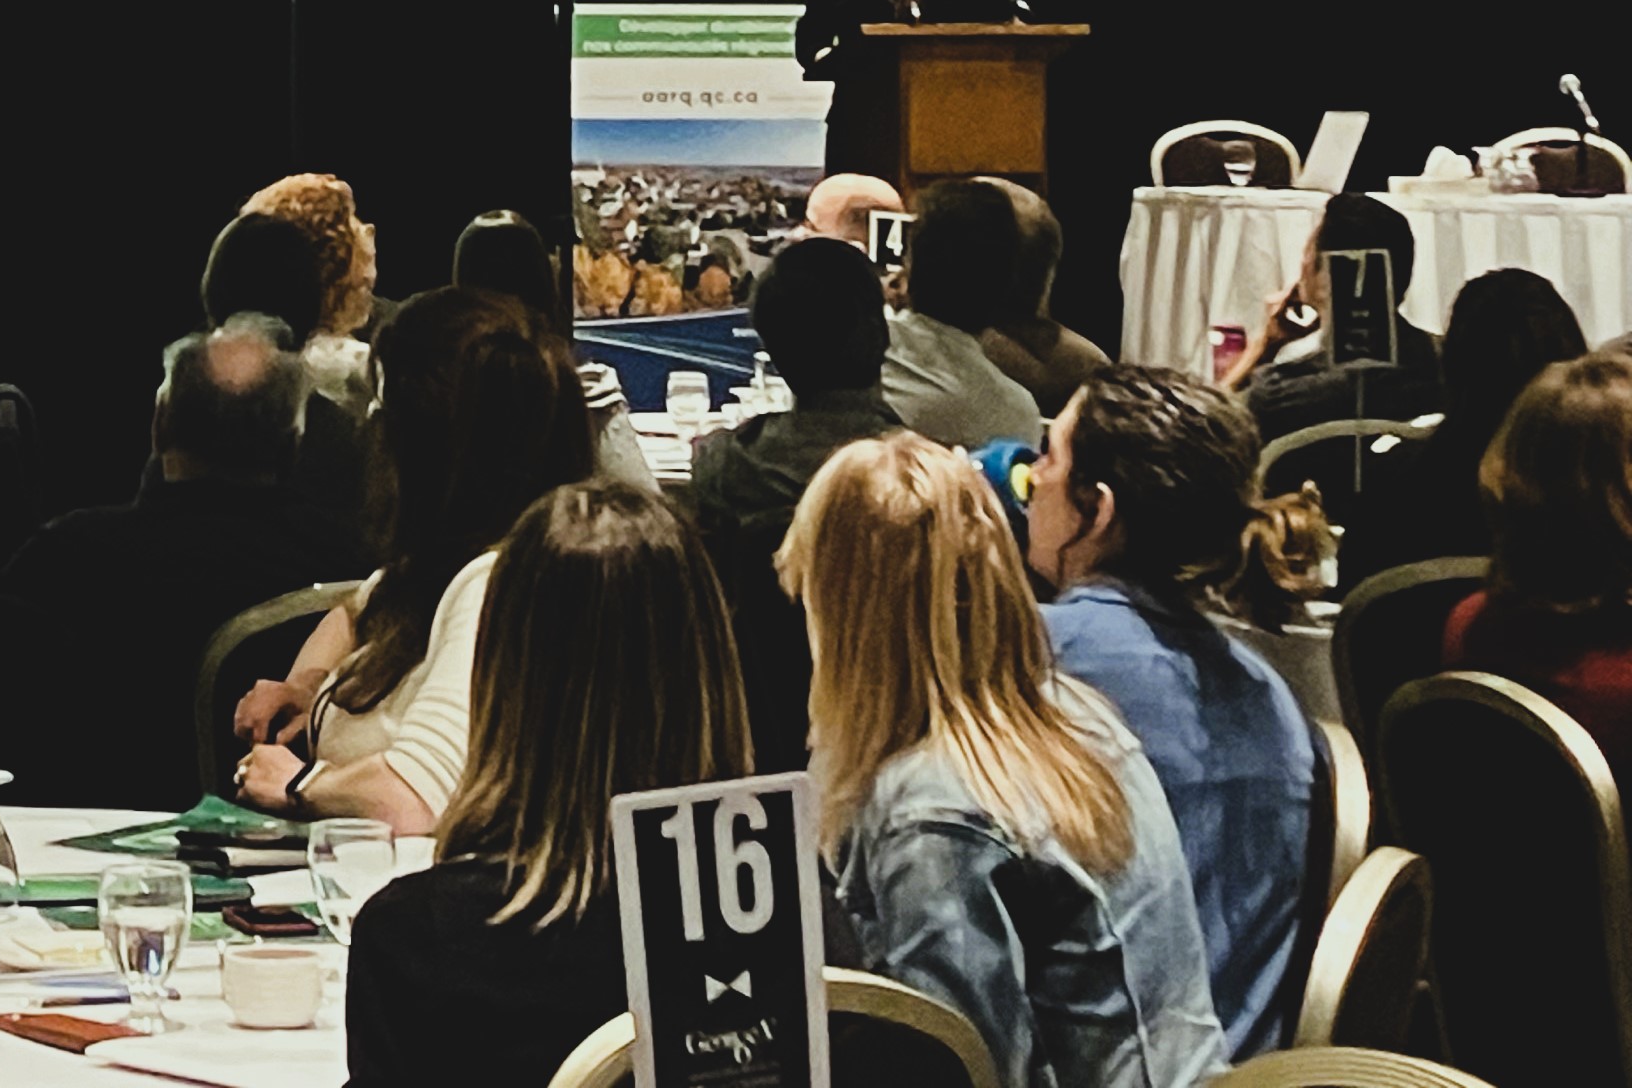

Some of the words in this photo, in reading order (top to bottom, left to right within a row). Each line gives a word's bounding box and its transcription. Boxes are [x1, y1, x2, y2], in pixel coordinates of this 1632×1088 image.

[885, 216, 904, 257] 4
[1343, 250, 1367, 298] 7
[660, 794, 775, 942] 16
